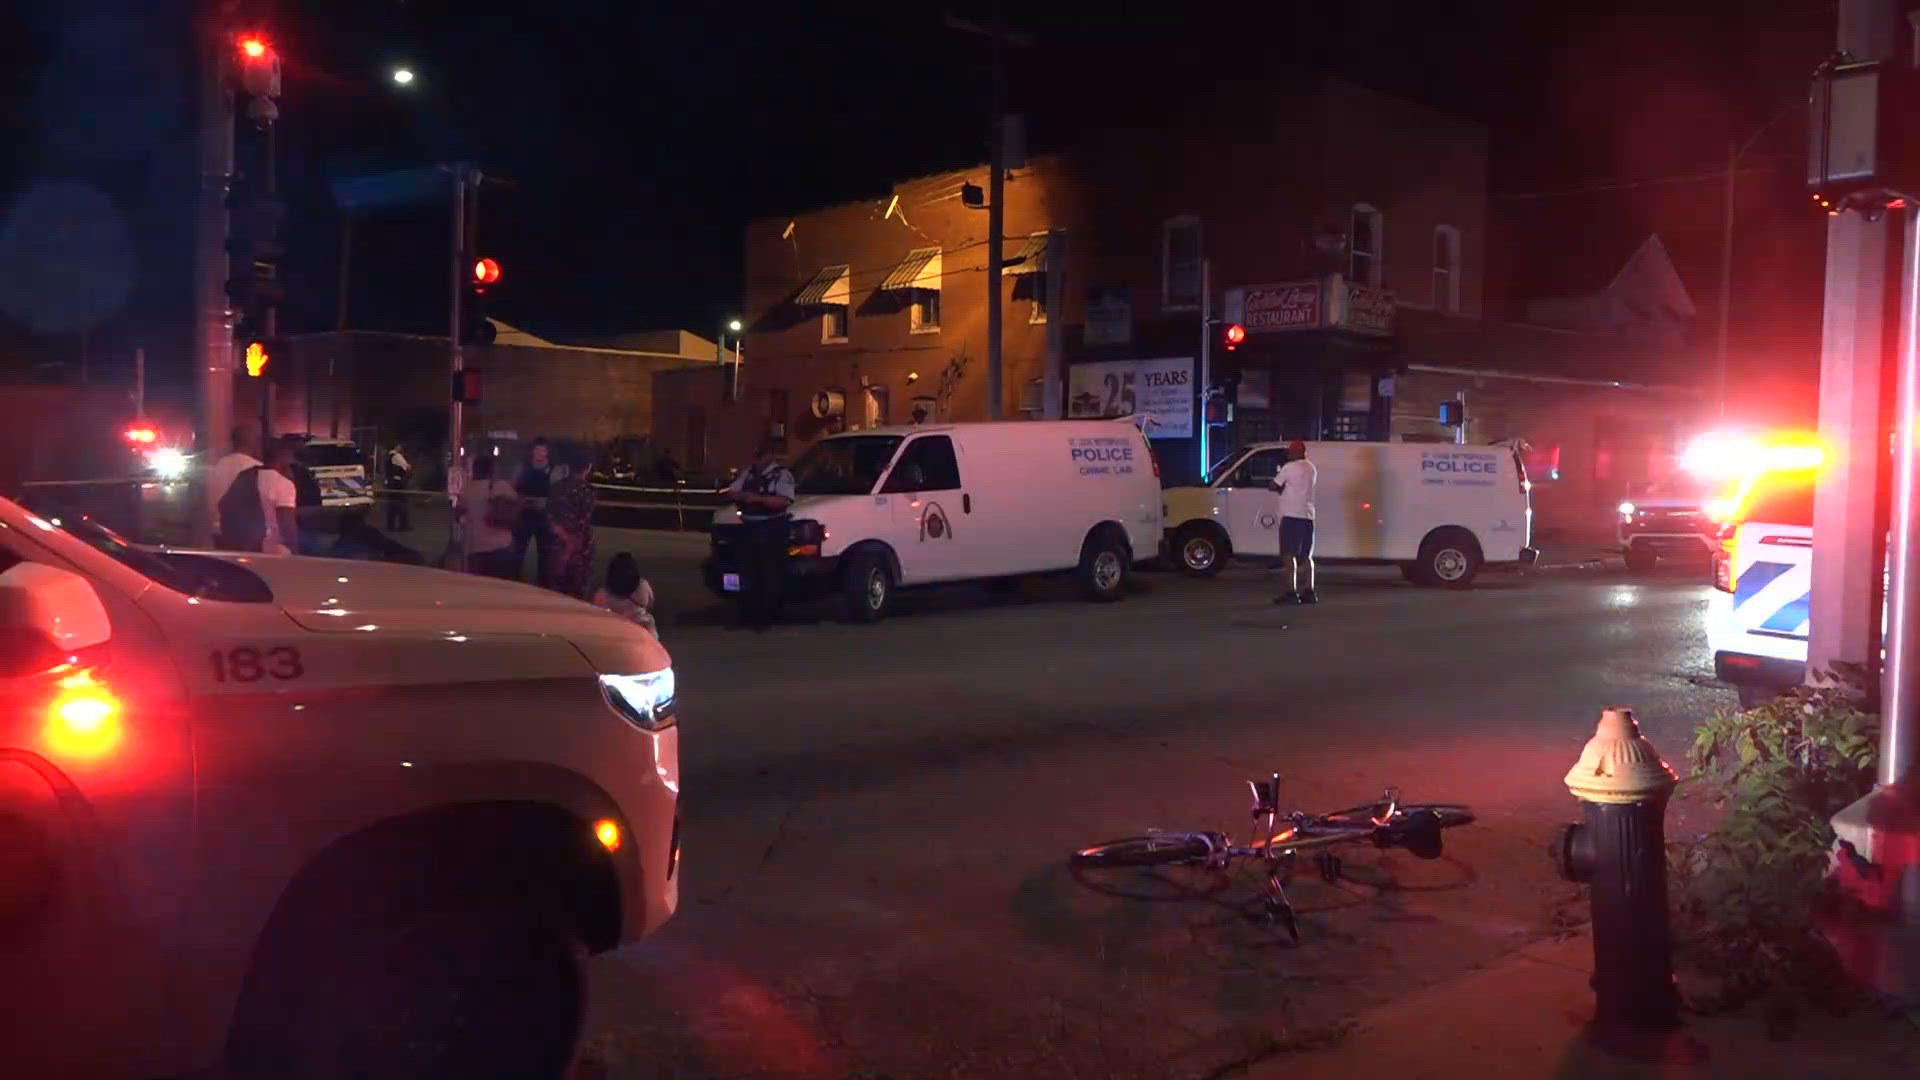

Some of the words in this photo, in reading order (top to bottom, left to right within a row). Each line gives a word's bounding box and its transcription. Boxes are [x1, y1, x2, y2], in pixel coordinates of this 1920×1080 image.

[1246, 308, 1312, 326] RESTAURANT
[1144, 370, 1188, 386] YEARS
[1104, 371, 1136, 415] 25
[1072, 448, 1133, 461] POLICE
[1422, 461, 1497, 473] POLICE
[210, 646, 304, 682] 183
